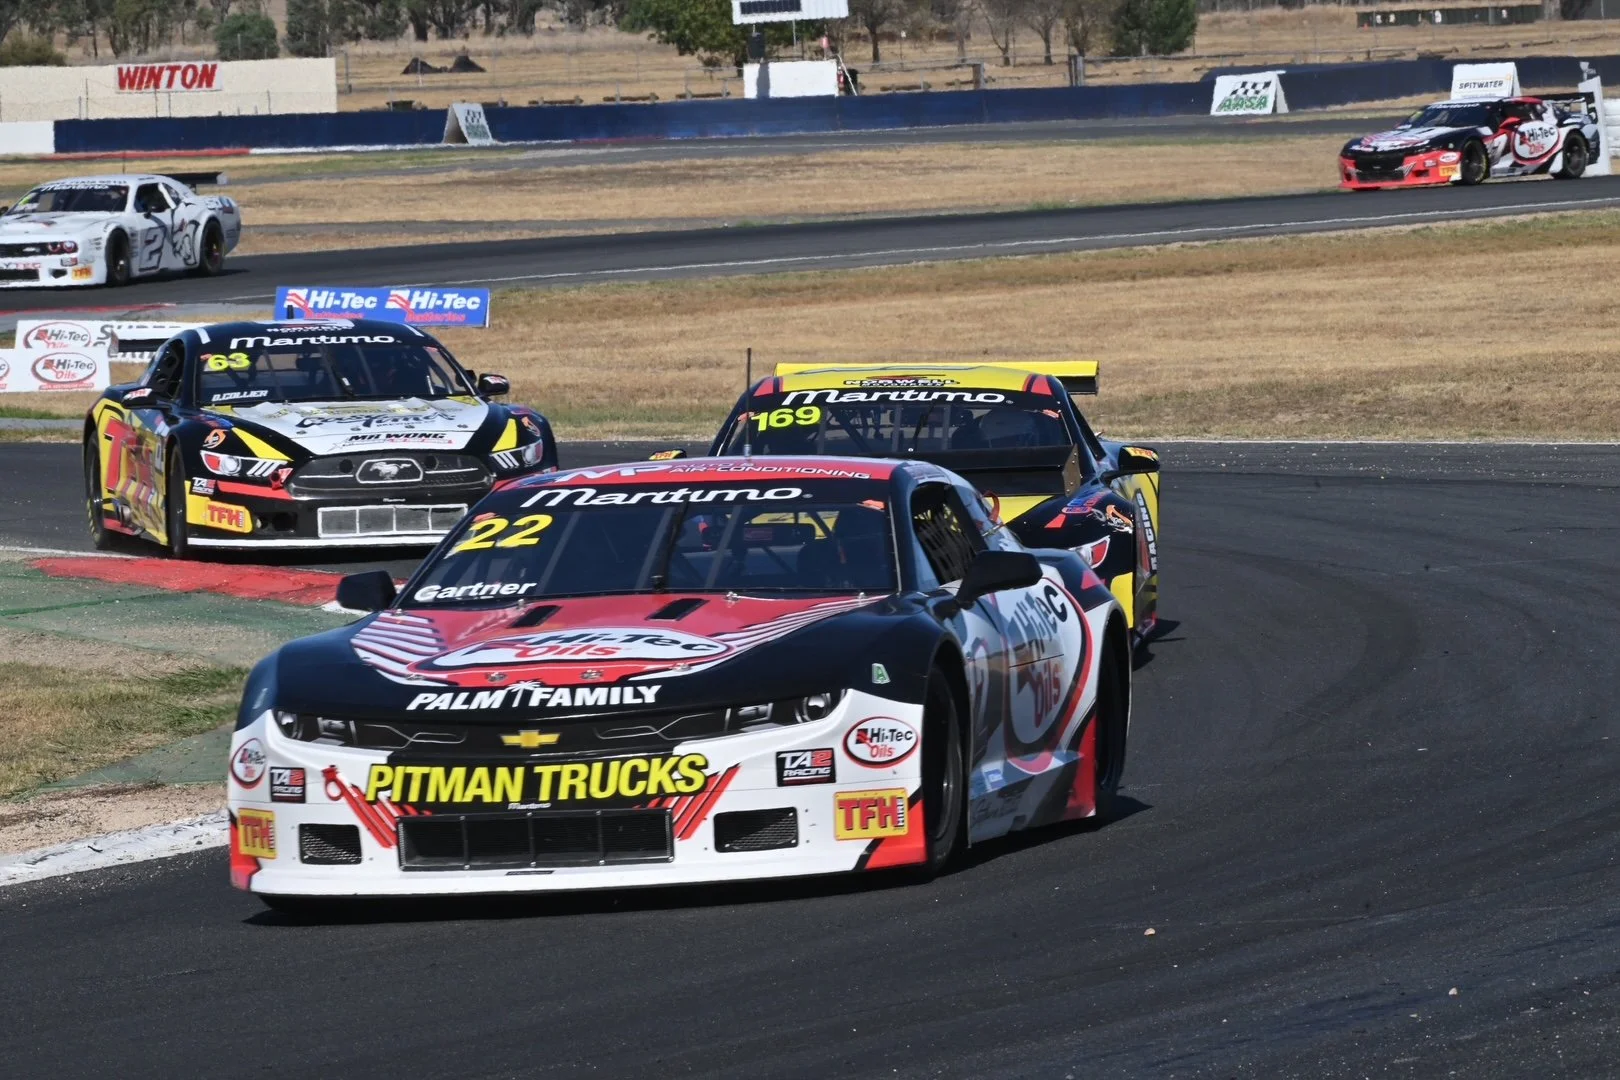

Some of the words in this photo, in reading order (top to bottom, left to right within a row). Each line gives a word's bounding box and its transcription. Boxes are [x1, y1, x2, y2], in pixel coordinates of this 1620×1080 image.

[117, 63, 218, 91] WINTON
[1458, 80, 1504, 89] SPITWATER
[1527, 126, 1557, 142] Hi-Tec
[308, 290, 378, 310] Hi-Tec
[408, 291, 481, 310] Hi-Tec
[48, 329, 89, 342] Hi-Tec
[56, 358, 94, 370] Hi-Tec
[207, 352, 252, 371] 63
[751, 406, 822, 432] 169
[207, 504, 241, 528] TFH
[452, 514, 554, 552] 22
[1136, 491, 1158, 571] RACING
[413, 582, 538, 601] Gartner
[513, 643, 622, 659] Oils
[529, 633, 721, 652] Hi-Tec
[406, 690, 507, 712] PALM
[528, 684, 663, 708] FAMILY
[869, 728, 913, 744] Hi-Tec
[778, 749, 833, 769] TA2
[869, 744, 895, 758] Oils
[270, 768, 305, 785] TA2
[365, 763, 527, 803] PITMAN
[533, 752, 707, 800] TRUCKS
[783, 767, 831, 777] RACING
[837, 795, 899, 831] TFH
[241, 815, 270, 849] TFH
